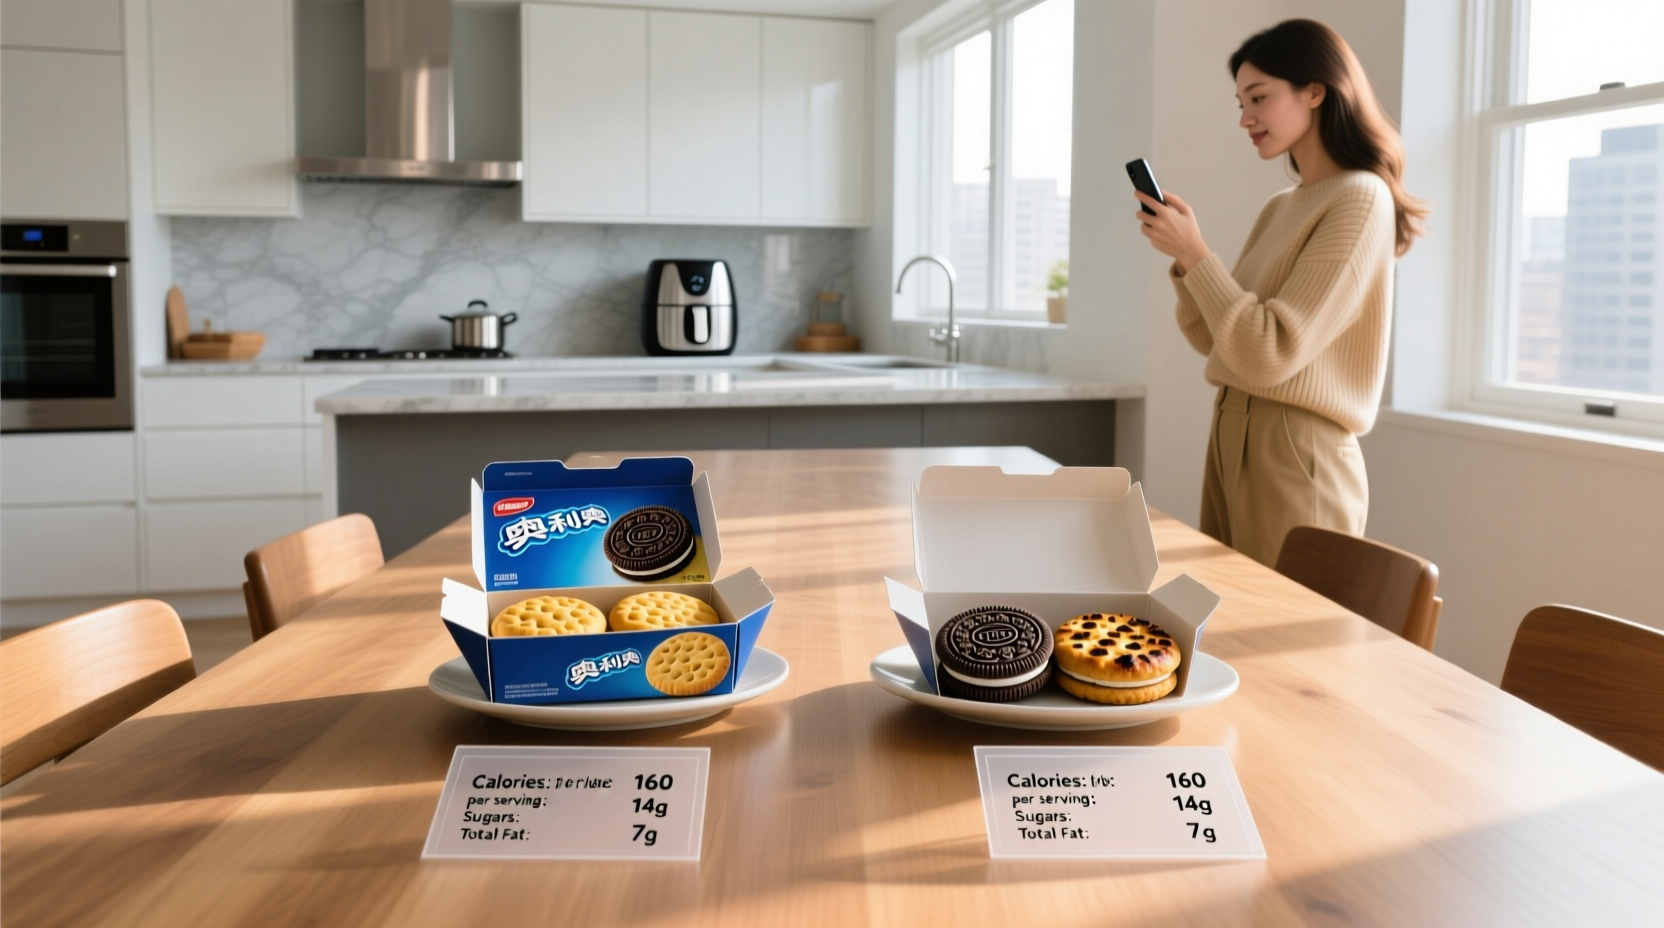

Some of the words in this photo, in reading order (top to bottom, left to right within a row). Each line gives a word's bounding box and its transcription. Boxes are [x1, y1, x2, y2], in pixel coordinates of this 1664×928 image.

[472, 773, 551, 789] Calories:
[634, 773, 674, 791] 160
[1007, 772, 1087, 788] Calories:
[1165, 772, 1206, 788] 160
[466, 796, 491, 809] per
[493, 793, 547, 809] serving:
[632, 797, 668, 818] 14g
[1012, 795, 1035, 808] per
[1039, 792, 1096, 808] serving:
[1172, 795, 1213, 816] 14g
[462, 810, 520, 826] Sugars:
[1014, 810, 1072, 826] Sugars:
[460, 827, 499, 840] Total
[502, 829, 531, 841] Fat:
[632, 824, 658, 847] 7g
[1017, 827, 1057, 840] Total
[1061, 827, 1089, 840] Fat:
[1185, 822, 1217, 843] 7g
